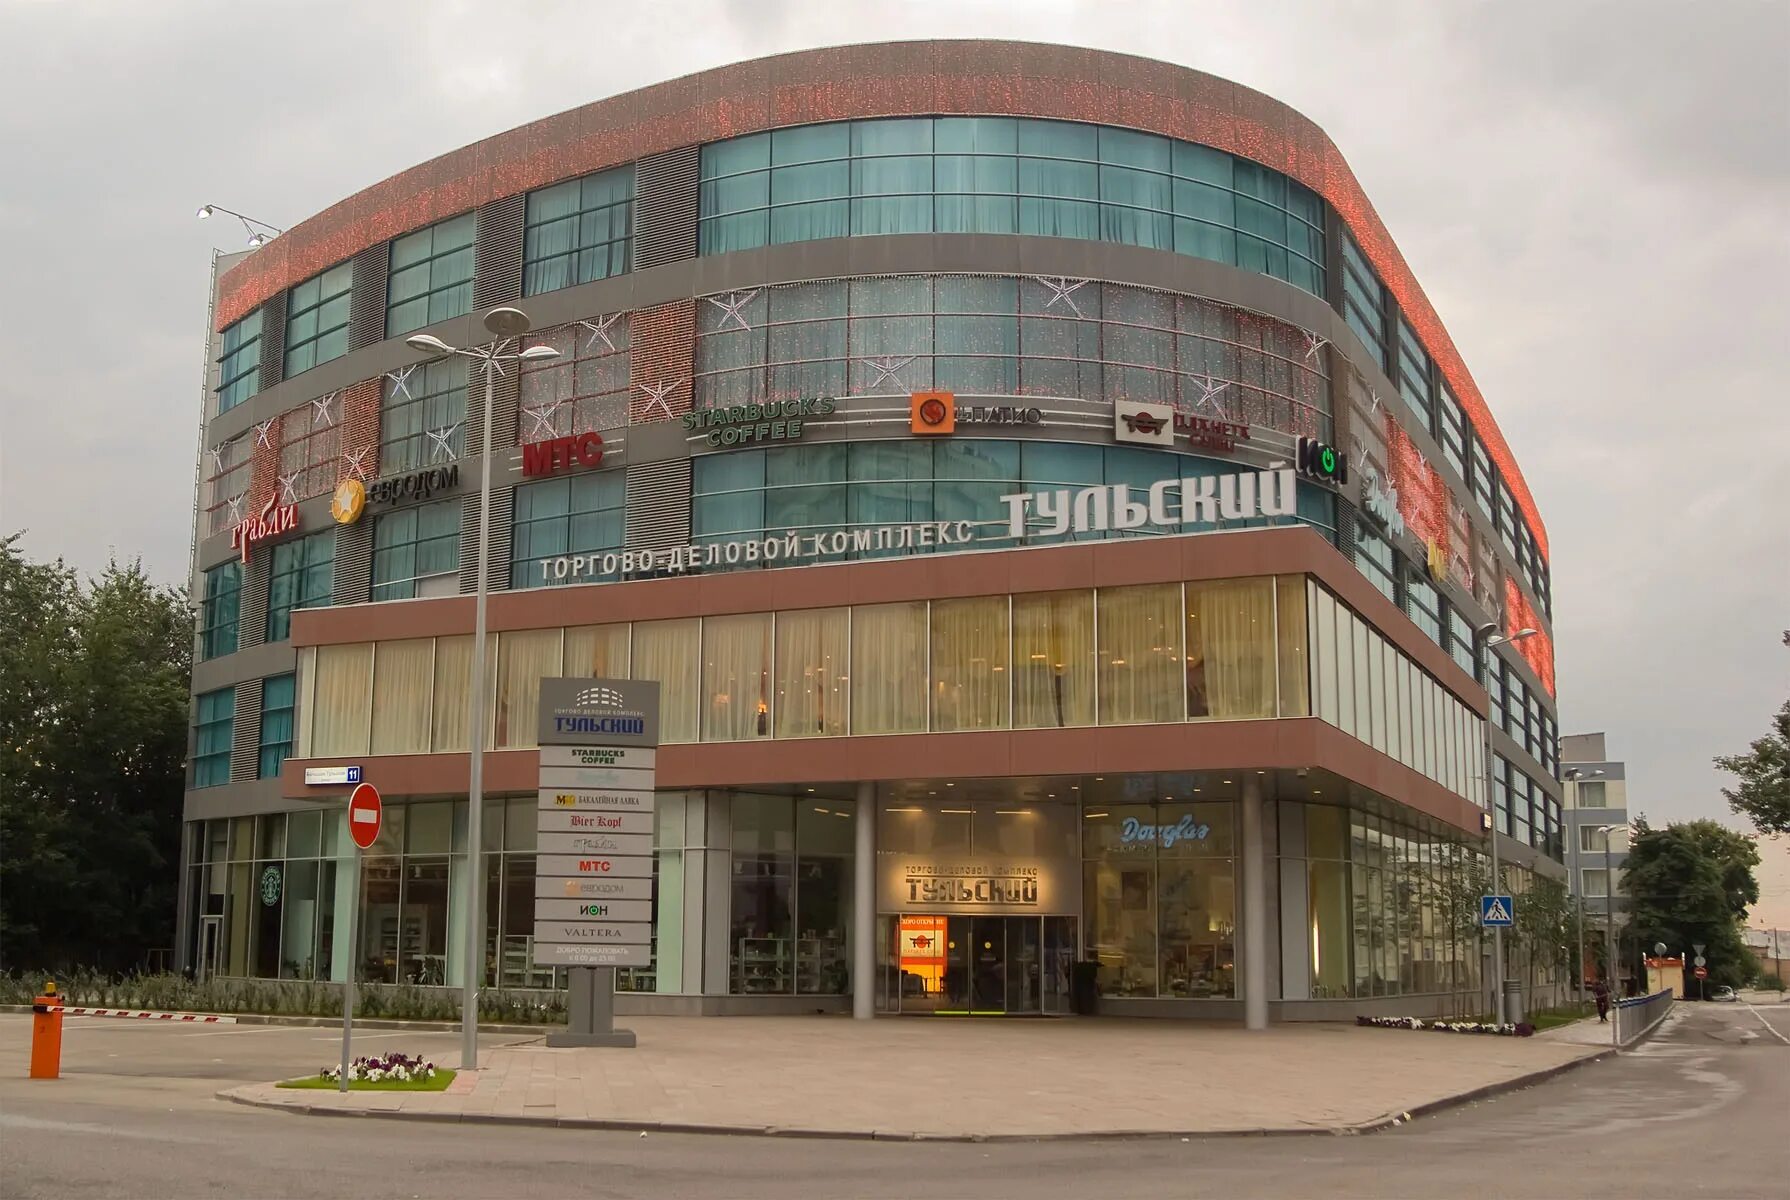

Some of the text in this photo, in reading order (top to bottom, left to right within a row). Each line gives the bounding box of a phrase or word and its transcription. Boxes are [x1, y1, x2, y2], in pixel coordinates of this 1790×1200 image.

[682, 397, 836, 430] STARBUCKS
[706, 420, 803, 447] COFFEE
[522, 432, 604, 477] МТС
[1000, 461, 1297, 538] ТУЛЬСКИЙ
[539, 519, 974, 580] ТОРГОВО-ДЕЛОВОЙ КОМПЛЕКС
[554, 716, 644, 734] ТУЛЬСКИЙ
[572, 749, 625, 757] STARBUCKS
[349, 770, 357, 780] 11
[571, 816, 623, 828] Bier Kopf
[1121, 814, 1210, 848] Douglas
[579, 861, 611, 871] МТС
[906, 877, 1038, 902] ТУЛЬСКИЙ
[565, 928, 621, 937] VALTERA
